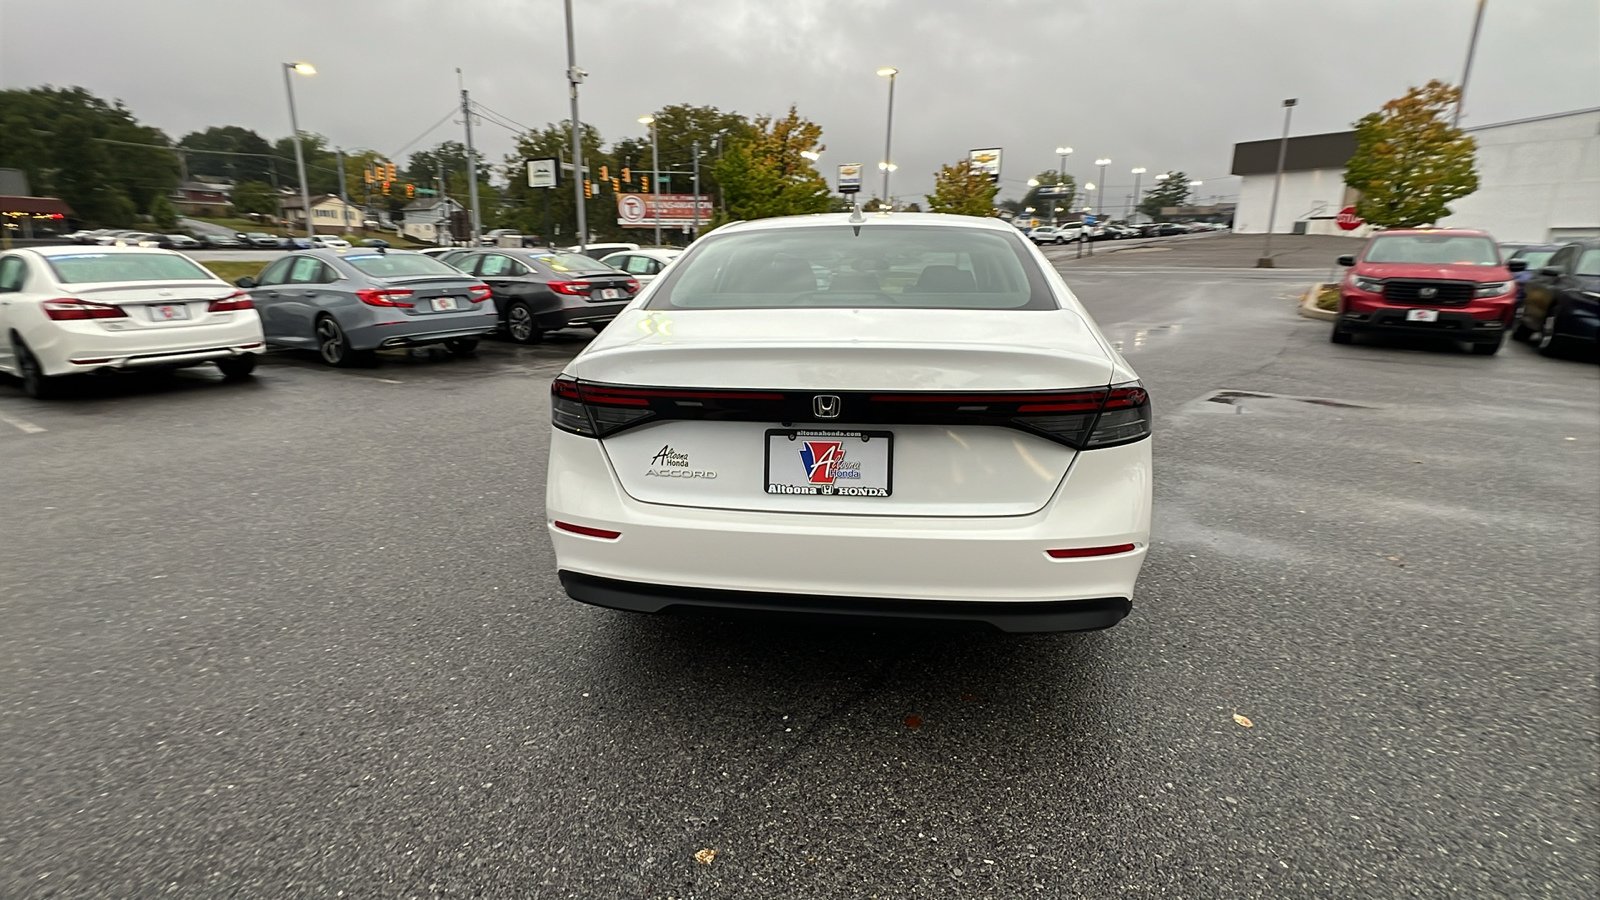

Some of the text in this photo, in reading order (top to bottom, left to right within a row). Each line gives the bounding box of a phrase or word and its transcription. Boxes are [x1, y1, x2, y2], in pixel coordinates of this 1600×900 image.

[1337, 213, 1362, 224] STO
[666, 459, 689, 467] Honda
[645, 469, 718, 479] ACCORD
[829, 469, 861, 479] Honda
[768, 484, 817, 494] Altoona
[838, 486, 888, 497] HONDA
